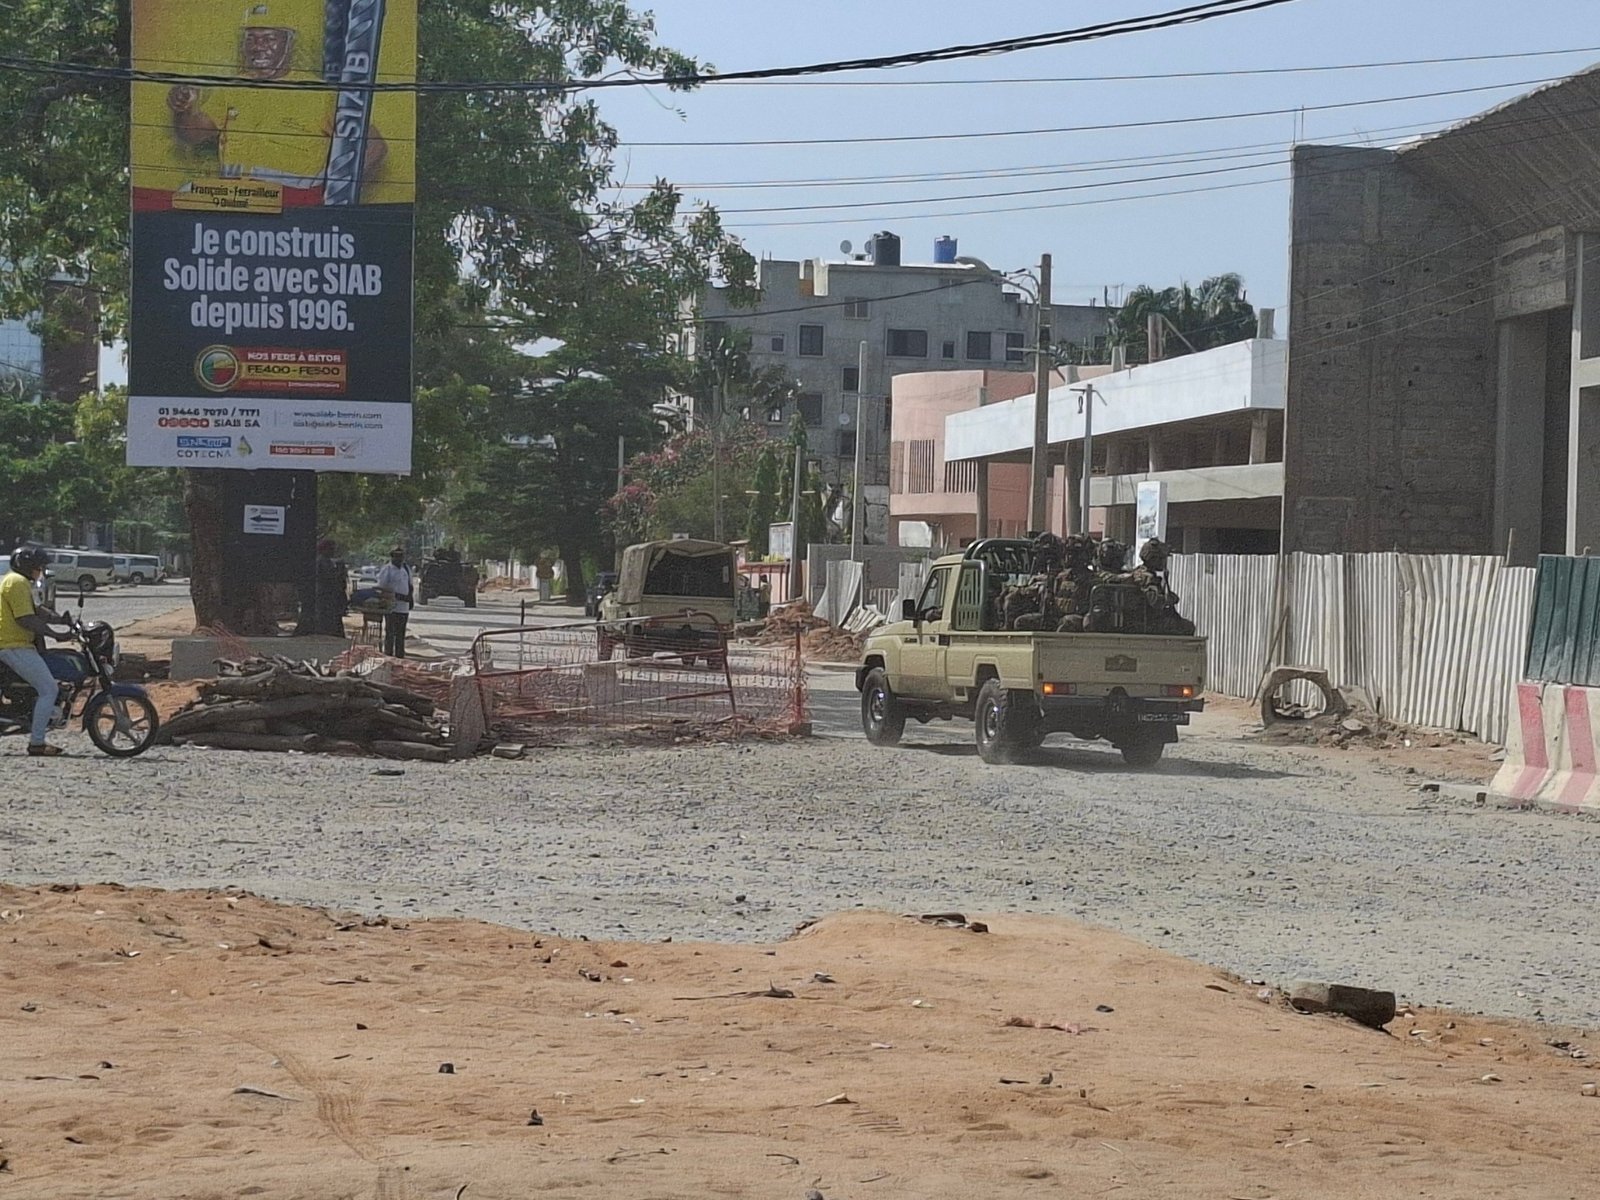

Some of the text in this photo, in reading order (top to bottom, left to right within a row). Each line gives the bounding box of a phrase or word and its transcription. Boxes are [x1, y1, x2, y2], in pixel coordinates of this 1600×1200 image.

[192, 223, 355, 259] Je construis
[163, 258, 382, 296] Solide avec SIAB
[191, 294, 355, 335] depuis 1996.
[247, 352, 269, 361] NOS
[271, 352, 296, 362] FERS
[247, 364, 290, 374] FE400
[158, 407, 170, 416] 01
[244, 419, 261, 428] SA
